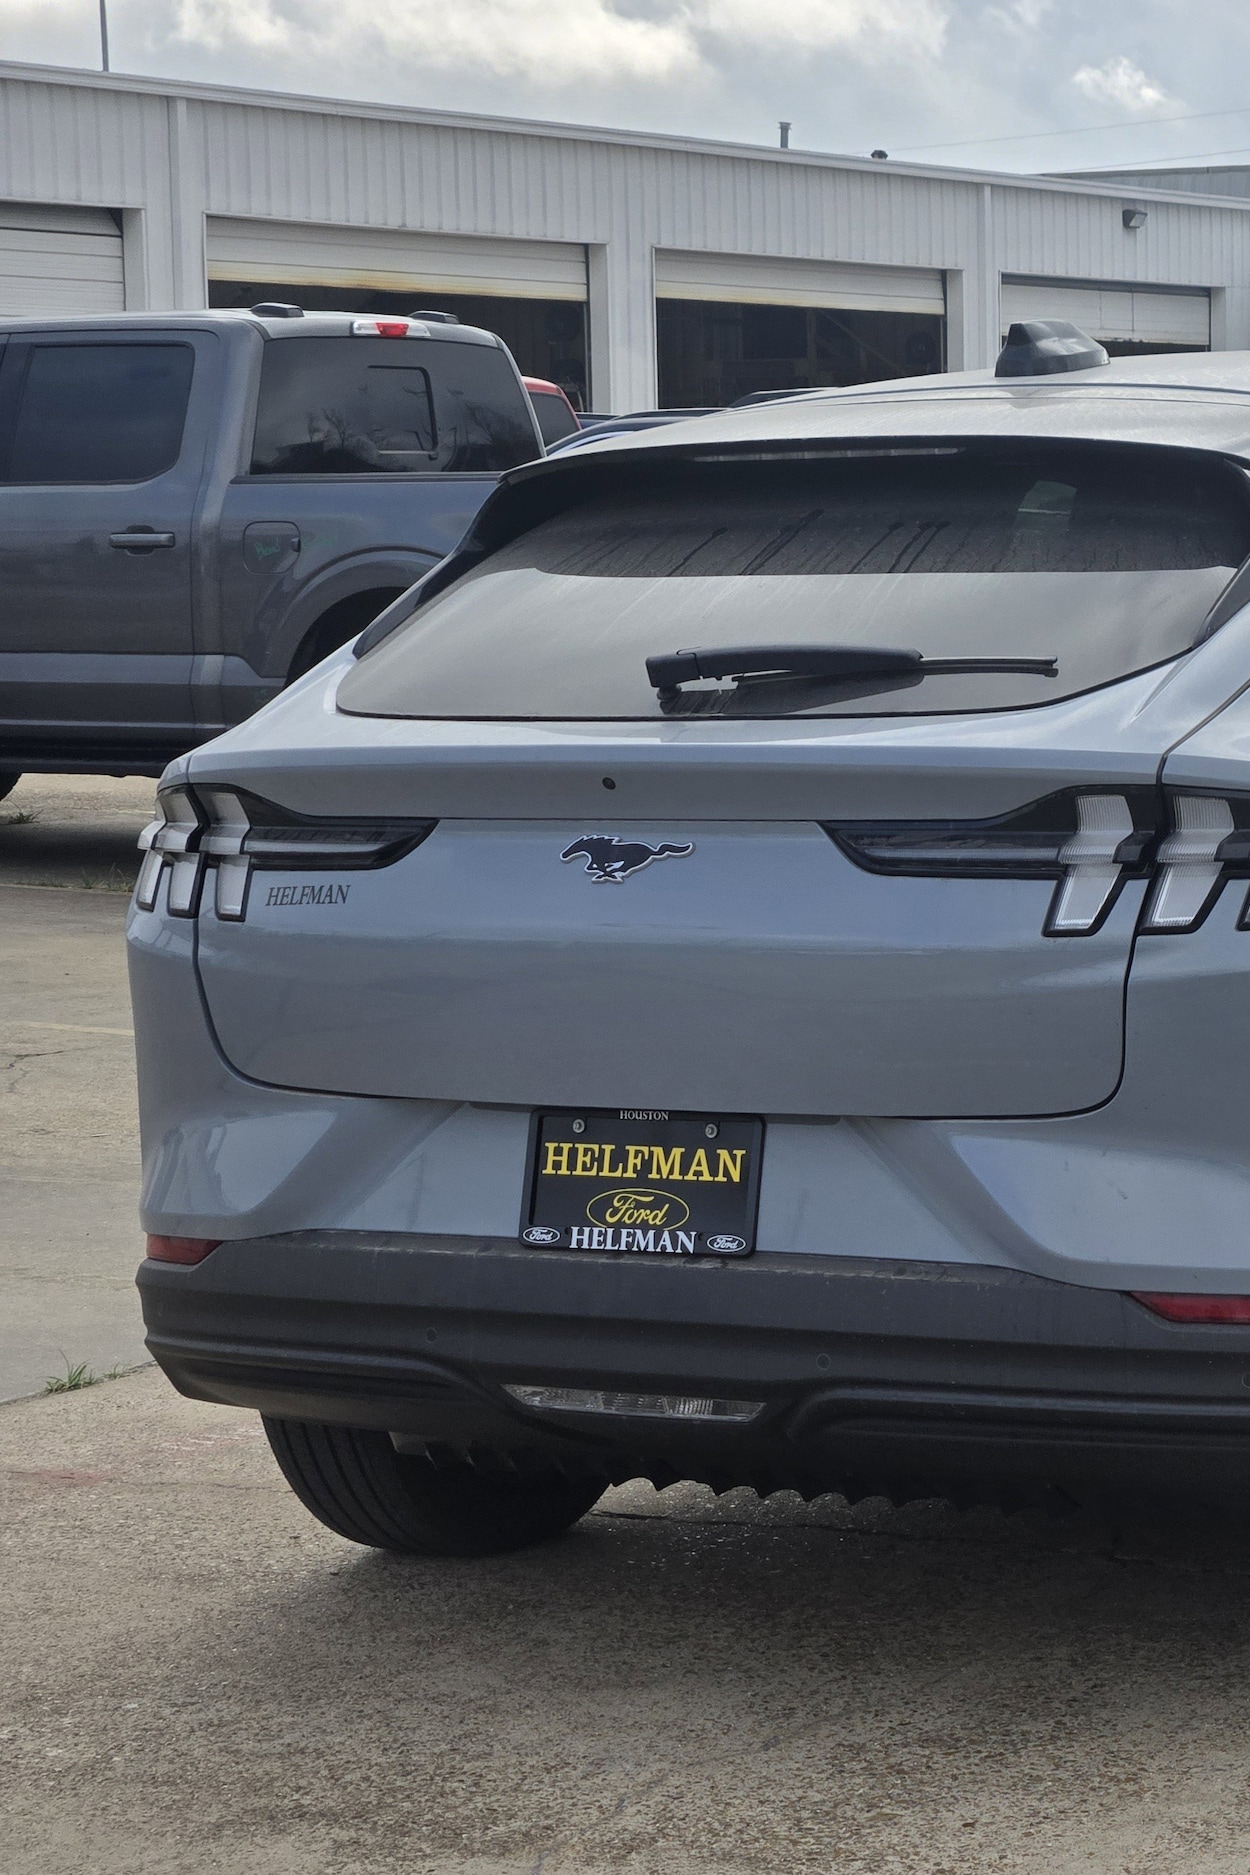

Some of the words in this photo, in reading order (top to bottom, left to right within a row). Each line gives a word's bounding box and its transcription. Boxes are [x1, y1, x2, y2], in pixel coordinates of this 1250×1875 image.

[265, 884, 351, 906] HELFMAN
[619, 1110, 670, 1121] HOUSTON
[542, 1142, 746, 1183] HELFMAN
[605, 1193, 670, 1225] Ford
[528, 1229, 553, 1241] Ford
[569, 1226, 696, 1254] HELFMAN
[712, 1236, 739, 1250] Ford
